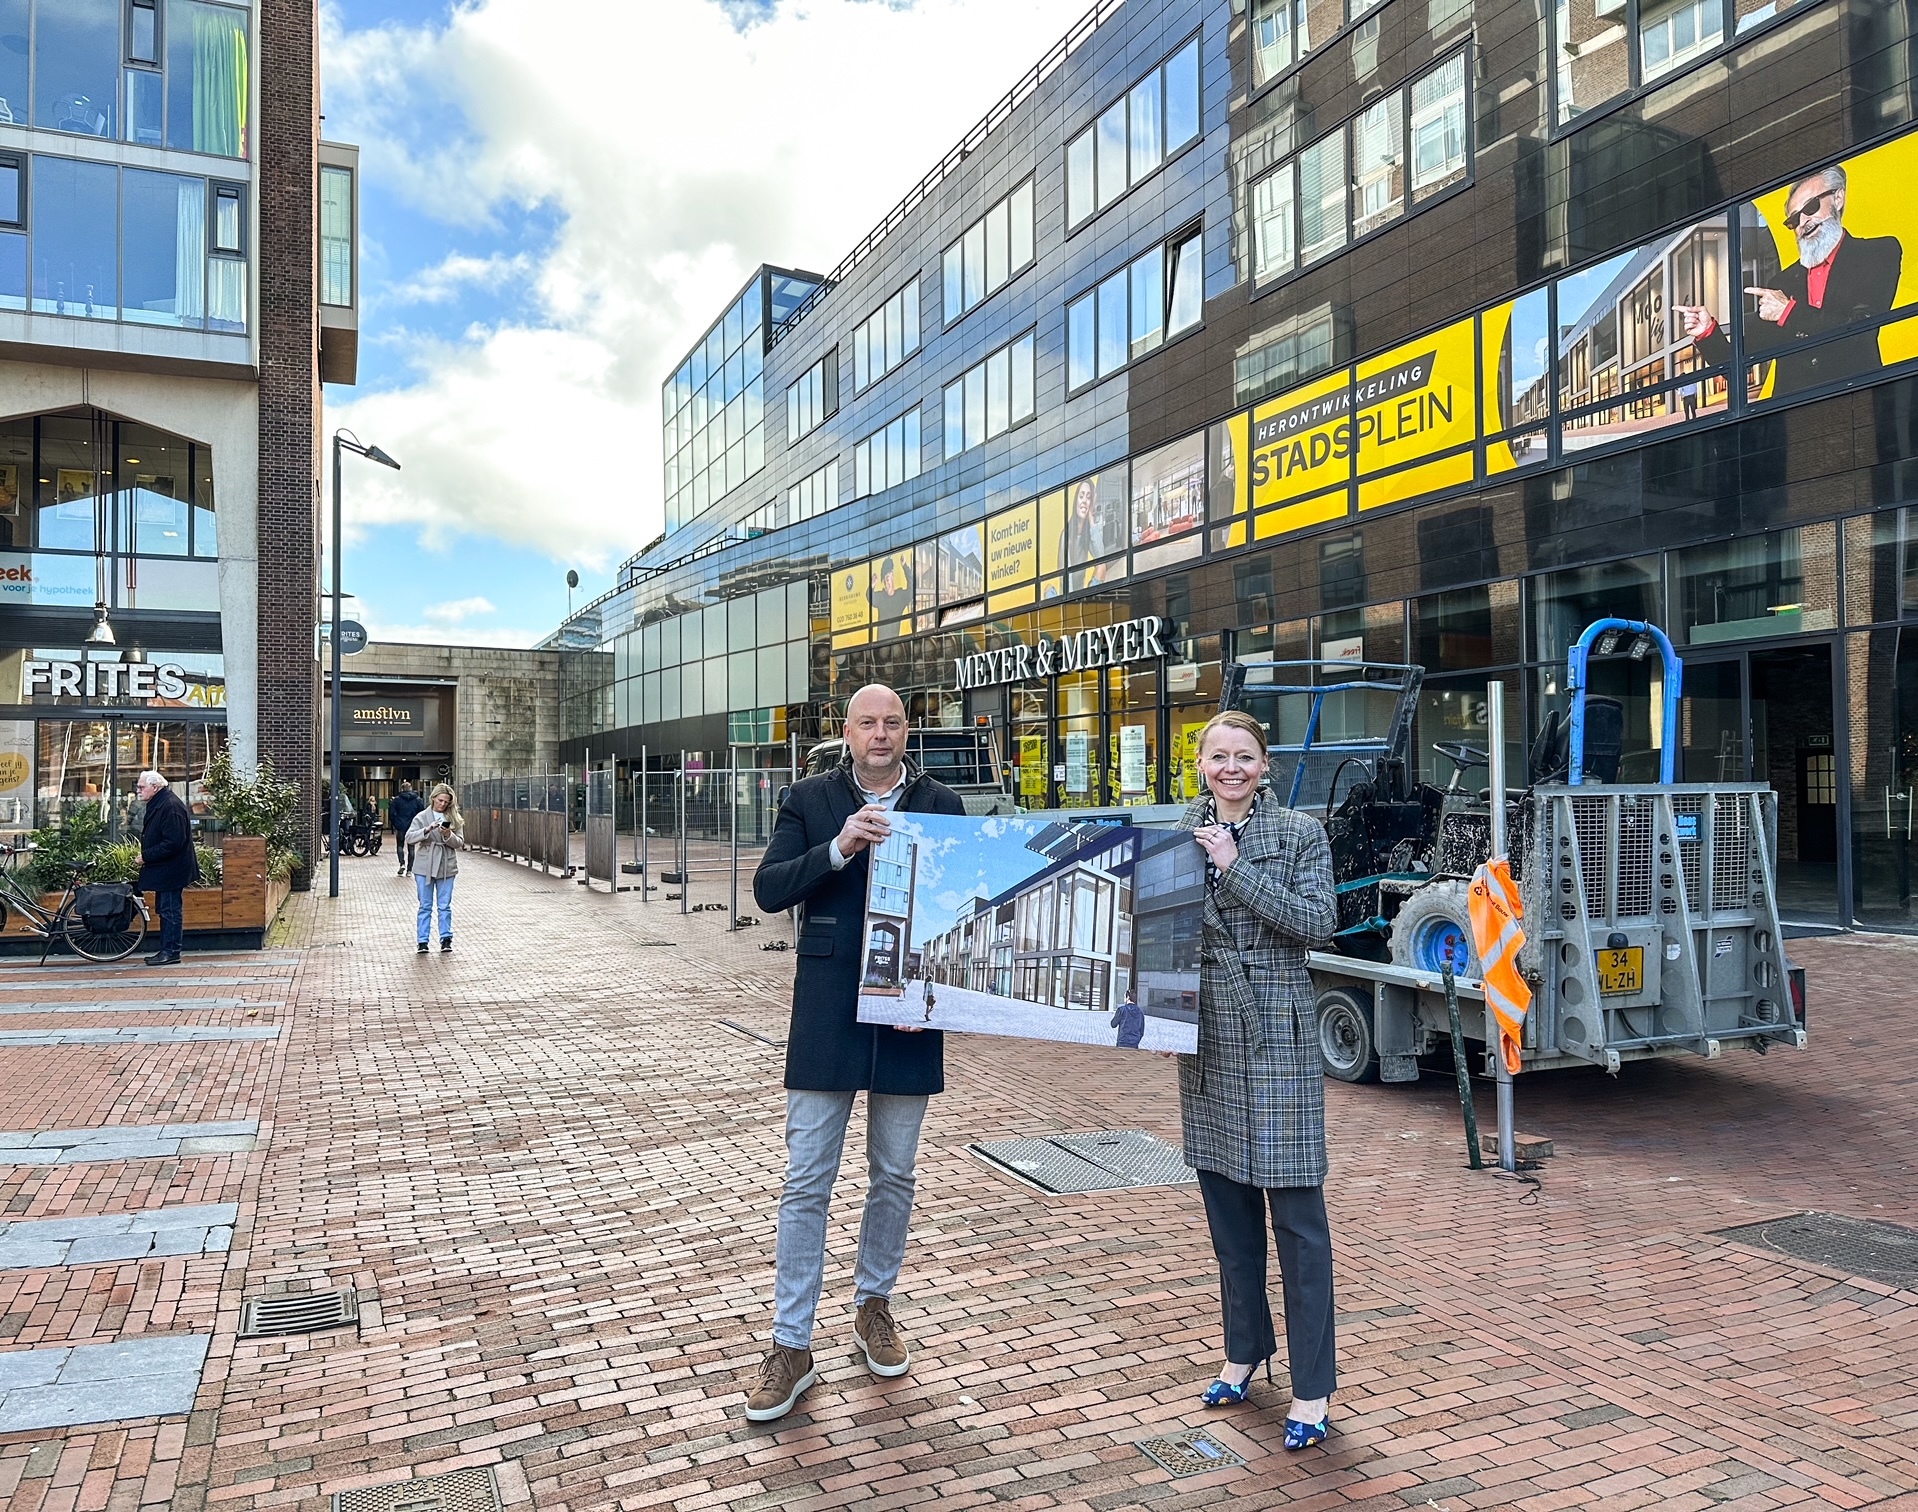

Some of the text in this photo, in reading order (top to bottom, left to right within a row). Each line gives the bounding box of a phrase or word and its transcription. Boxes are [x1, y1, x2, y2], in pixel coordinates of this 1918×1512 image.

[1258, 365, 1422, 441] HERONTWIKKELING
[1253, 384, 1453, 486] STADSPLEIN
[991, 519, 1030, 543] Komt hier
[991, 538, 1033, 562] uw nieuwe
[991, 559, 1021, 581] winkel?
[2, 584, 94, 595] voor je hypotheek
[954, 615, 1167, 690] MEYER & MEYER
[23, 660, 187, 699] FRITES
[353, 706, 411, 719] amstlvn
[1611, 951, 1628, 968] 34
